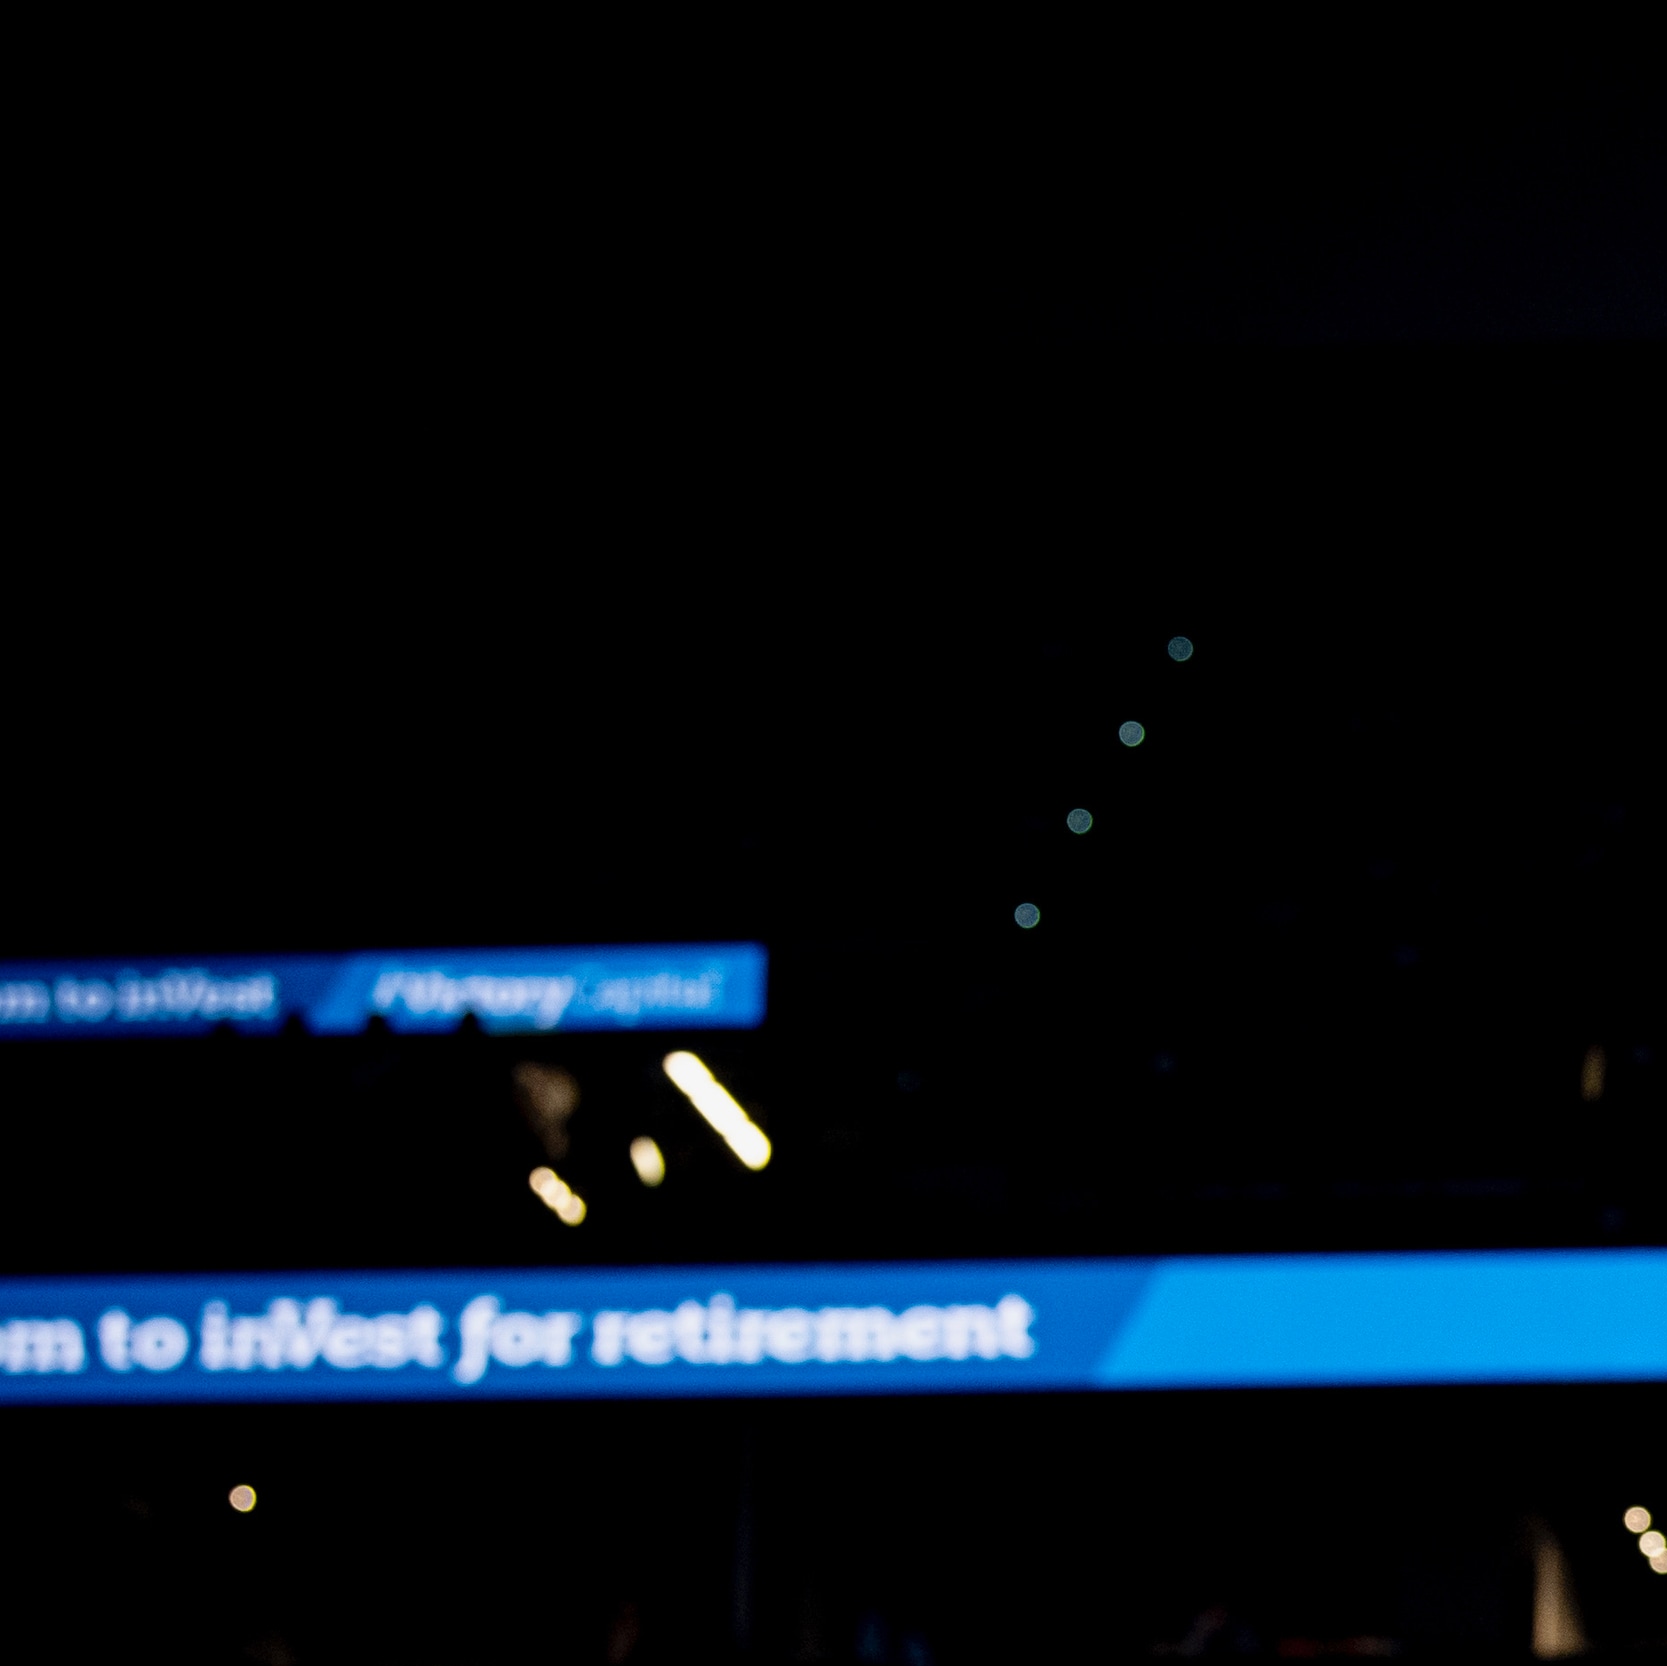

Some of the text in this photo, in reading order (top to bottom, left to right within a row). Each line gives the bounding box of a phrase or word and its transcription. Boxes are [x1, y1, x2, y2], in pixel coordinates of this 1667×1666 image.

[98, 1308, 190, 1374] to
[453, 1294, 584, 1386] for
[592, 1290, 1037, 1368] retirement
